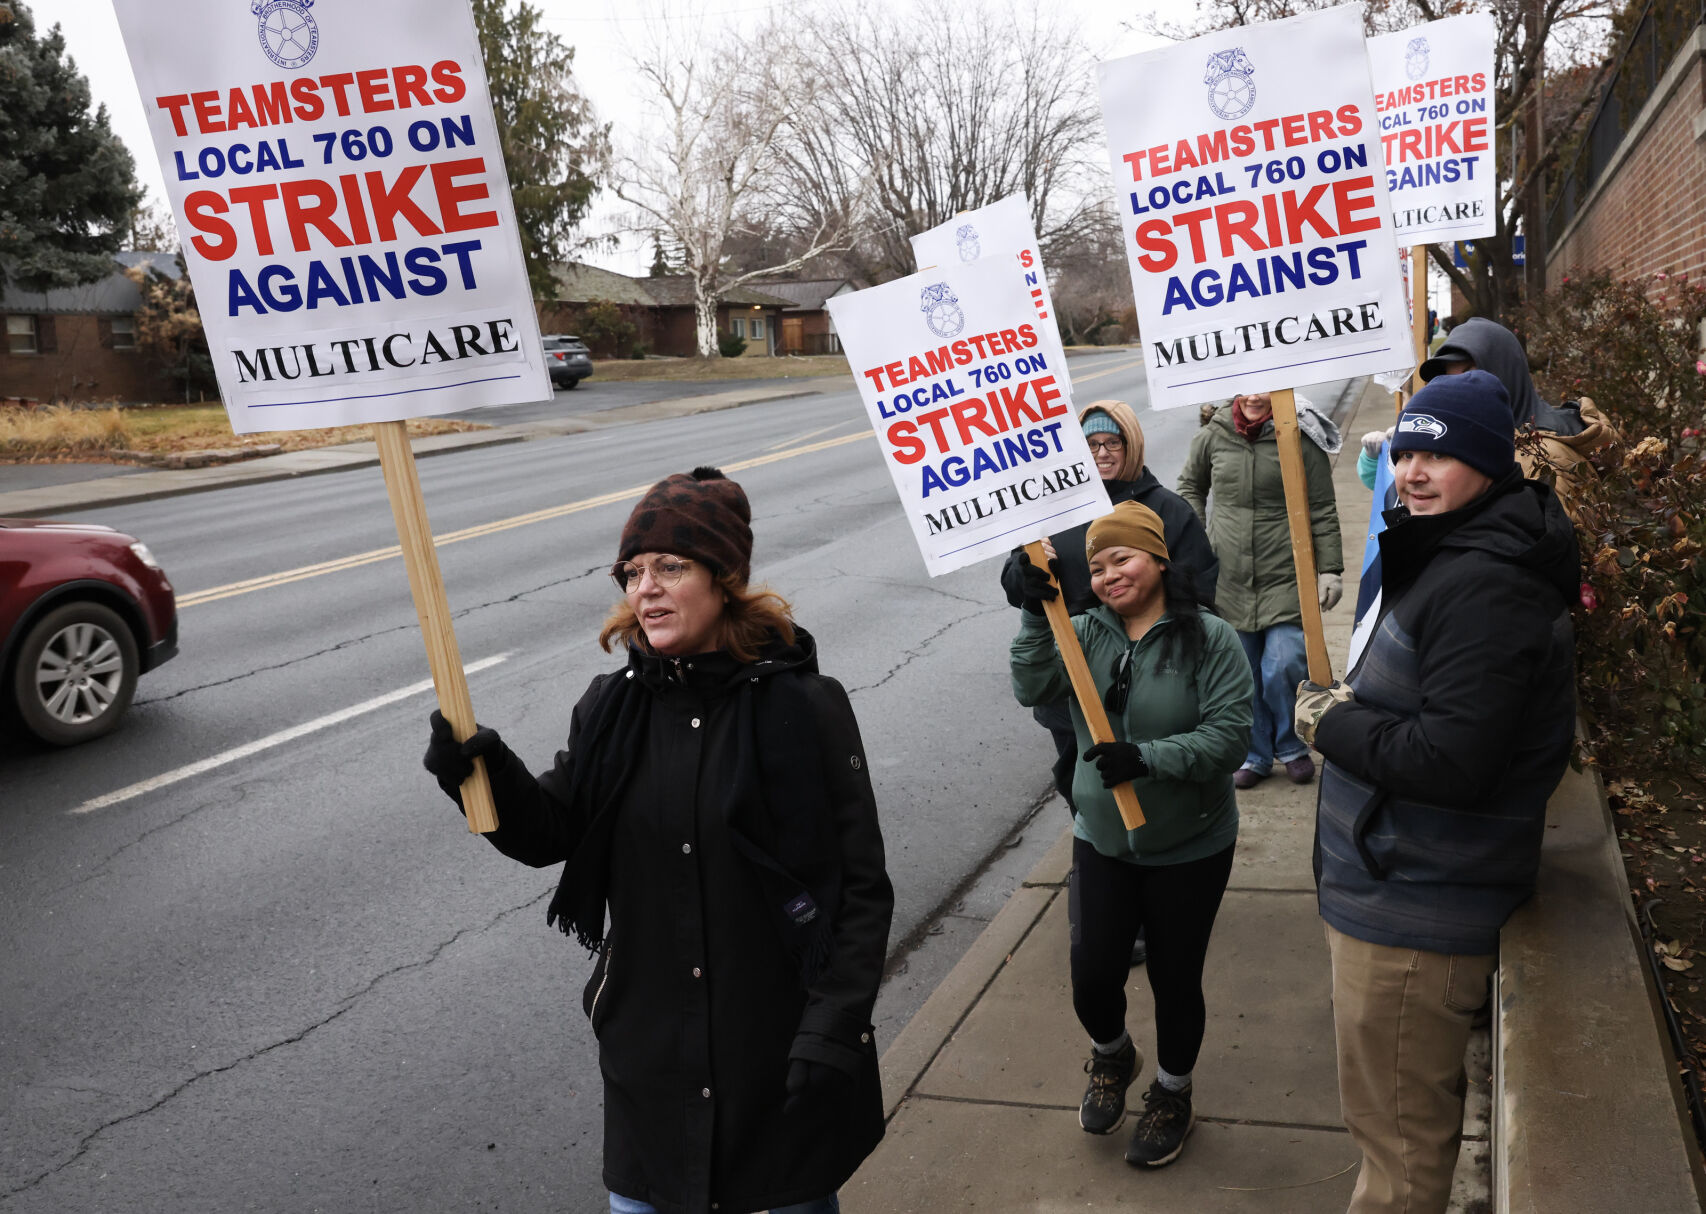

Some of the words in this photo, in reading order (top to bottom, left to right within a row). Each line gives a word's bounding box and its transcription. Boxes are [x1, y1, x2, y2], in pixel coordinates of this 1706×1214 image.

[157, 60, 466, 137] TEAMSTERS
[1375, 73, 1486, 112] EAMSTERS
[1378, 112, 1412, 130] CAL
[1417, 103, 1449, 122] 760
[1456, 98, 1485, 114] ON
[175, 139, 304, 181] LOCAL
[313, 126, 393, 164] 760
[407, 115, 475, 152] ON
[1123, 104, 1363, 182] TEAMSTERS
[1381, 117, 1488, 166] TRIKE
[1385, 156, 1479, 192] GAINST
[184, 157, 498, 261] STRIKE
[1130, 172, 1235, 215] LOCAL
[1244, 156, 1305, 188] 760
[1317, 144, 1367, 174] ON
[1393, 200, 1484, 228] LTICARE
[1135, 176, 1381, 274] STRIKE
[229, 240, 482, 316] AGAINST
[1162, 241, 1367, 315] AGAINST
[231, 319, 519, 382] MULTICARE
[864, 323, 1038, 392] TEAMSTERS
[1152, 302, 1383, 369] MULTICARE
[877, 379, 964, 420] LOCAL
[968, 362, 1011, 388] 760
[1014, 353, 1047, 377] ON
[887, 375, 1068, 465] STRIKE
[922, 422, 1064, 498] AGAINST
[923, 462, 1090, 536] MULTICARE
